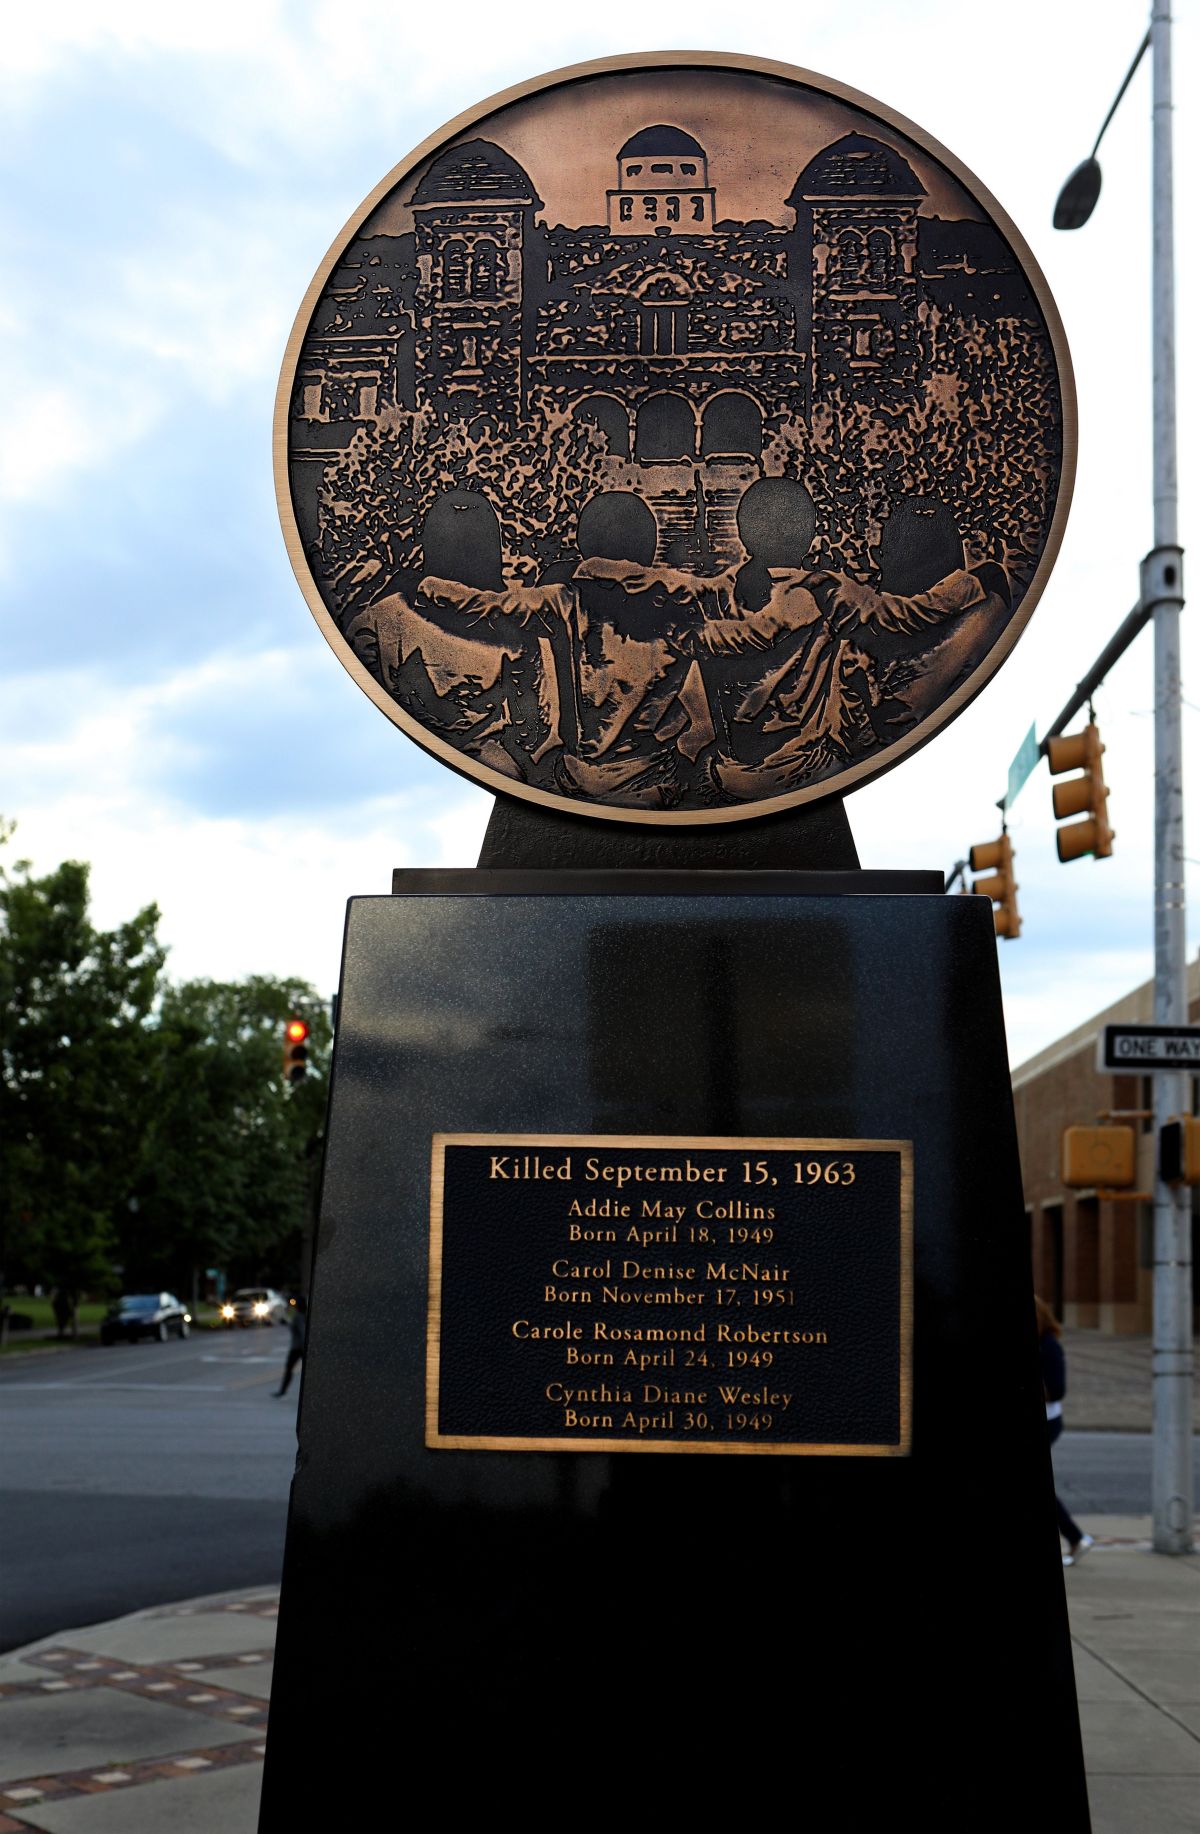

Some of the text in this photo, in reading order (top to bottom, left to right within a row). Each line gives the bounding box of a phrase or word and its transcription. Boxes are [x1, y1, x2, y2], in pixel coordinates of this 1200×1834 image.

[1119, 1038, 1156, 1056] ONE
[488, 1155, 856, 1189] Killed September 15, 1963
[567, 1198, 776, 1224] Addie May Collins
[569, 1224, 774, 1248] Born April 18, 1949
[551, 1259, 790, 1282] Carol Denise McNair
[544, 1285, 794, 1306] Born November 17, 1951
[511, 1319, 828, 1344] Carole Rosamond Robertson
[566, 1346, 614, 1365] Born
[623, 1348, 675, 1372] April
[727, 1350, 774, 1368] 1949
[545, 1382, 791, 1410] Cynthia Diane Wesley
[564, 1408, 773, 1434] Born April 30, 1949
